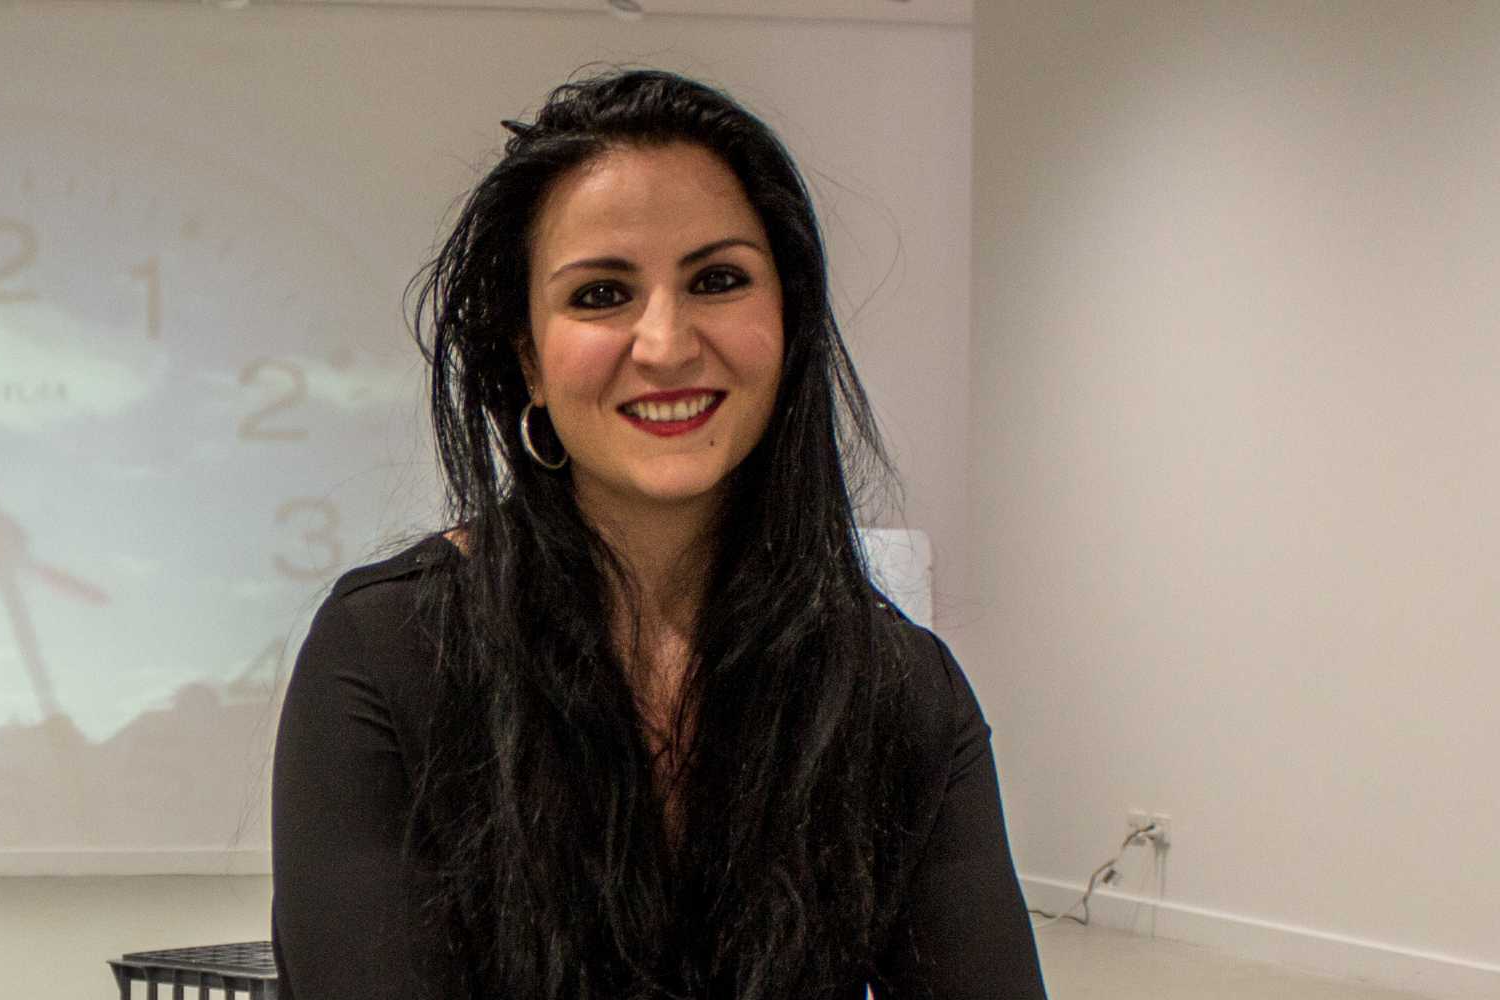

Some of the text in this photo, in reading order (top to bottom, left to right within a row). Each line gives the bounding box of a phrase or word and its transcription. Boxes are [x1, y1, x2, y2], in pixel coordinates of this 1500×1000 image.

[129, 255, 162, 341] 1
[236, 357, 309, 442] 2
[272, 496, 344, 581] 3
